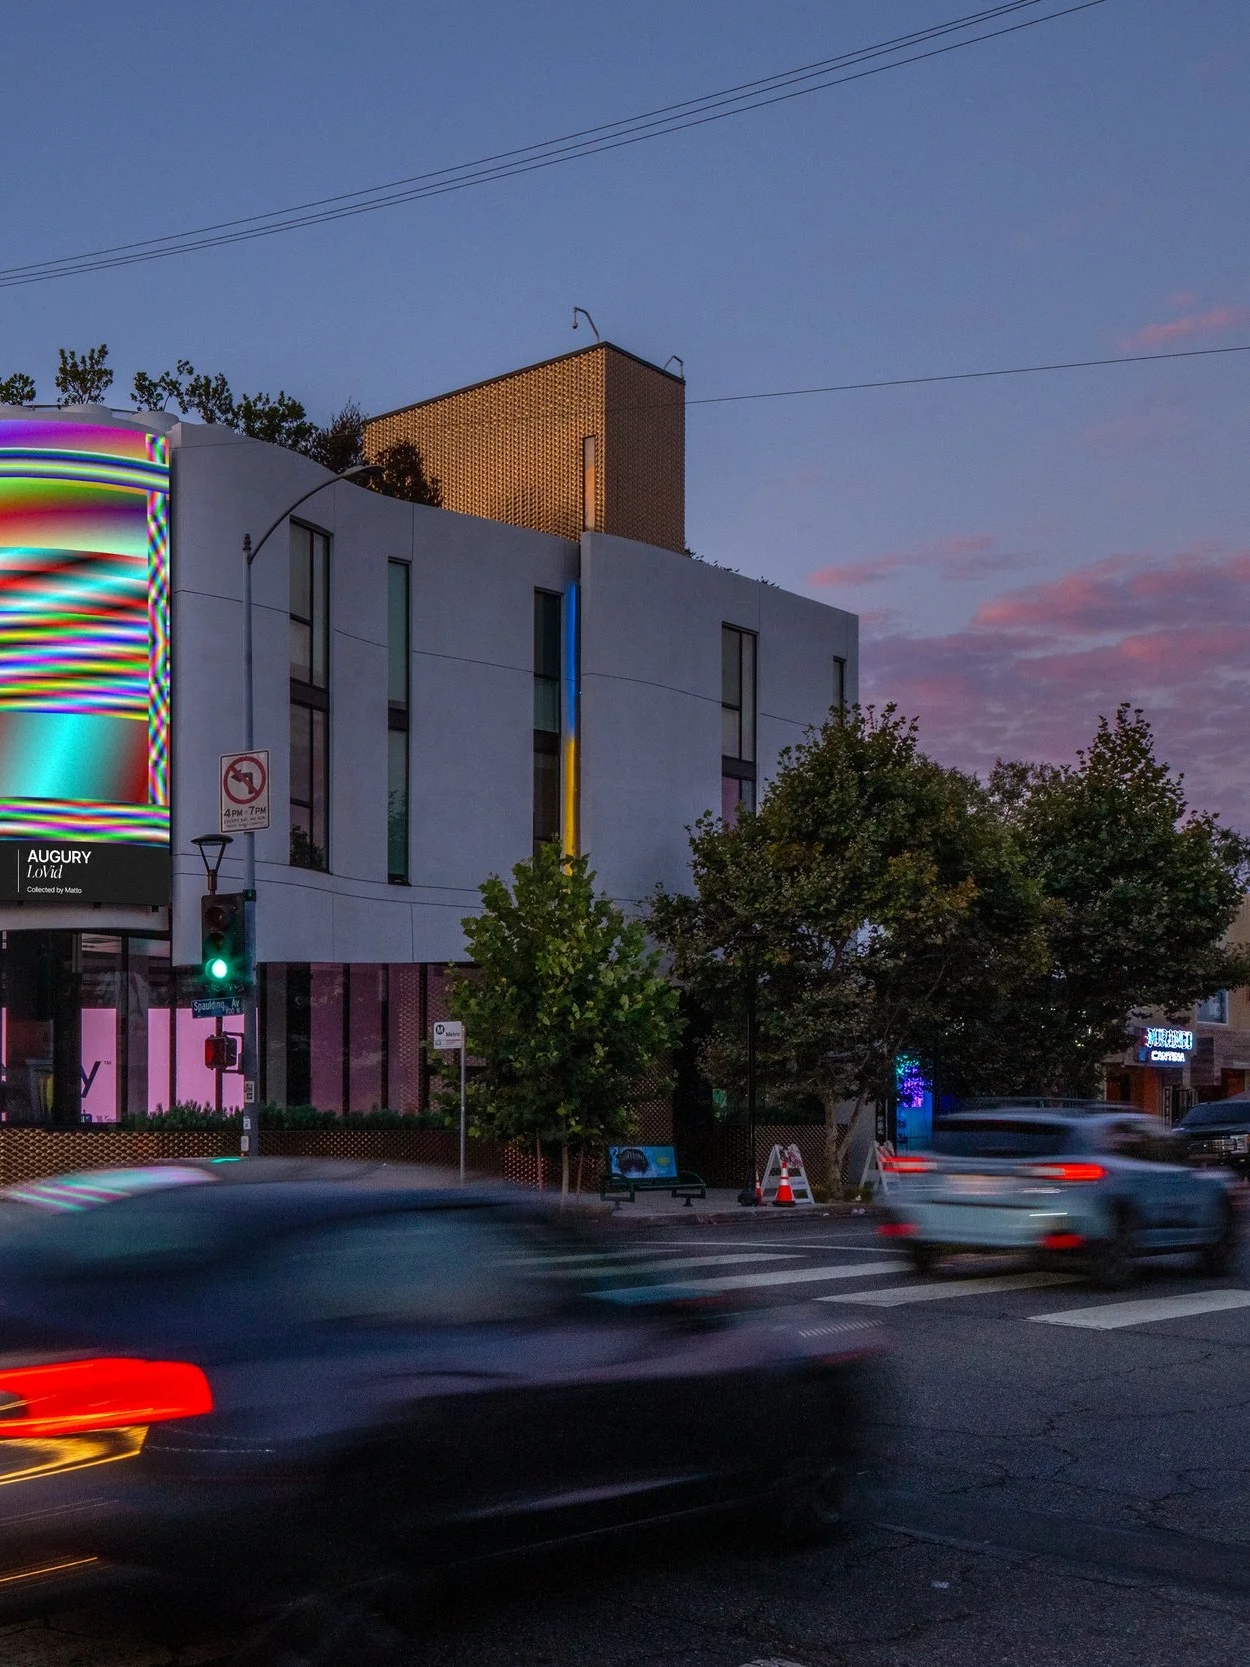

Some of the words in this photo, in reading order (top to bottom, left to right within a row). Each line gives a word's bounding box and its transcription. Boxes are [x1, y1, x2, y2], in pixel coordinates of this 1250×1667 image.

[223, 808, 243, 818] 4PM
[248, 805, 267, 816] 7PM
[27, 849, 92, 864] AUGURY
[27, 864, 63, 879] LoVid
[26, 886, 56, 894] Collected
[56, 887, 64, 895] by
[193, 1000, 225, 1014] Spaulding
[231, 997, 240, 1008] Av
